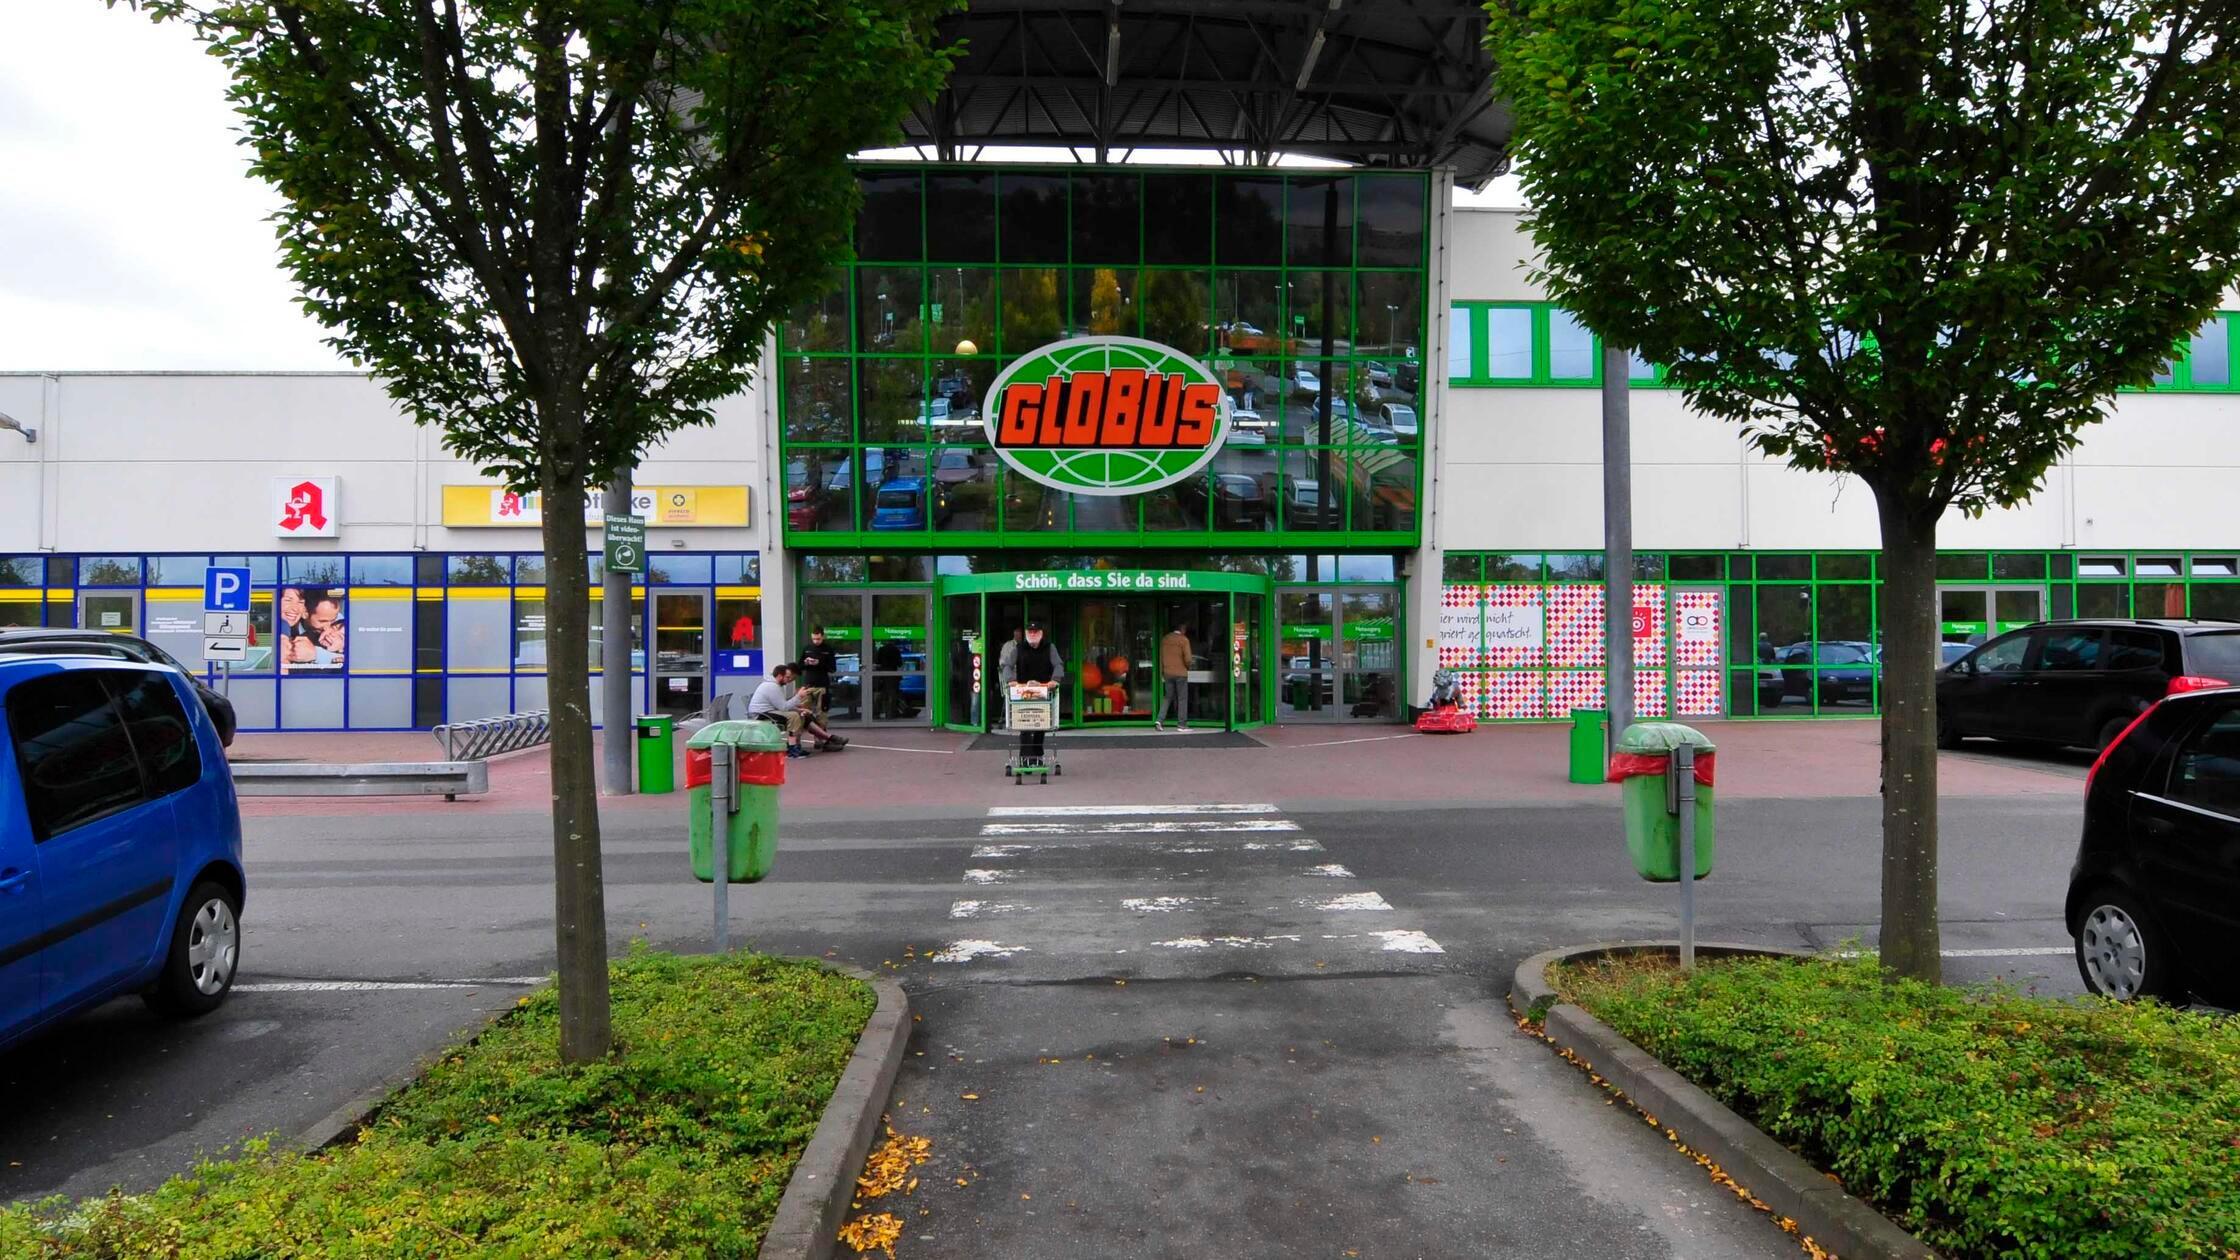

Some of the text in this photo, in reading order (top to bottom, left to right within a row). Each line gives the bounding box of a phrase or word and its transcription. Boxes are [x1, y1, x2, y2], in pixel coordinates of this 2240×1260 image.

[996, 368, 1221, 449] GLOBUS
[214, 572, 240, 606] P
[1015, 572, 1191, 590] Schön, dass Sie da sind.
[1440, 613, 1454, 625] ier
[1486, 610, 1514, 624] nicht
